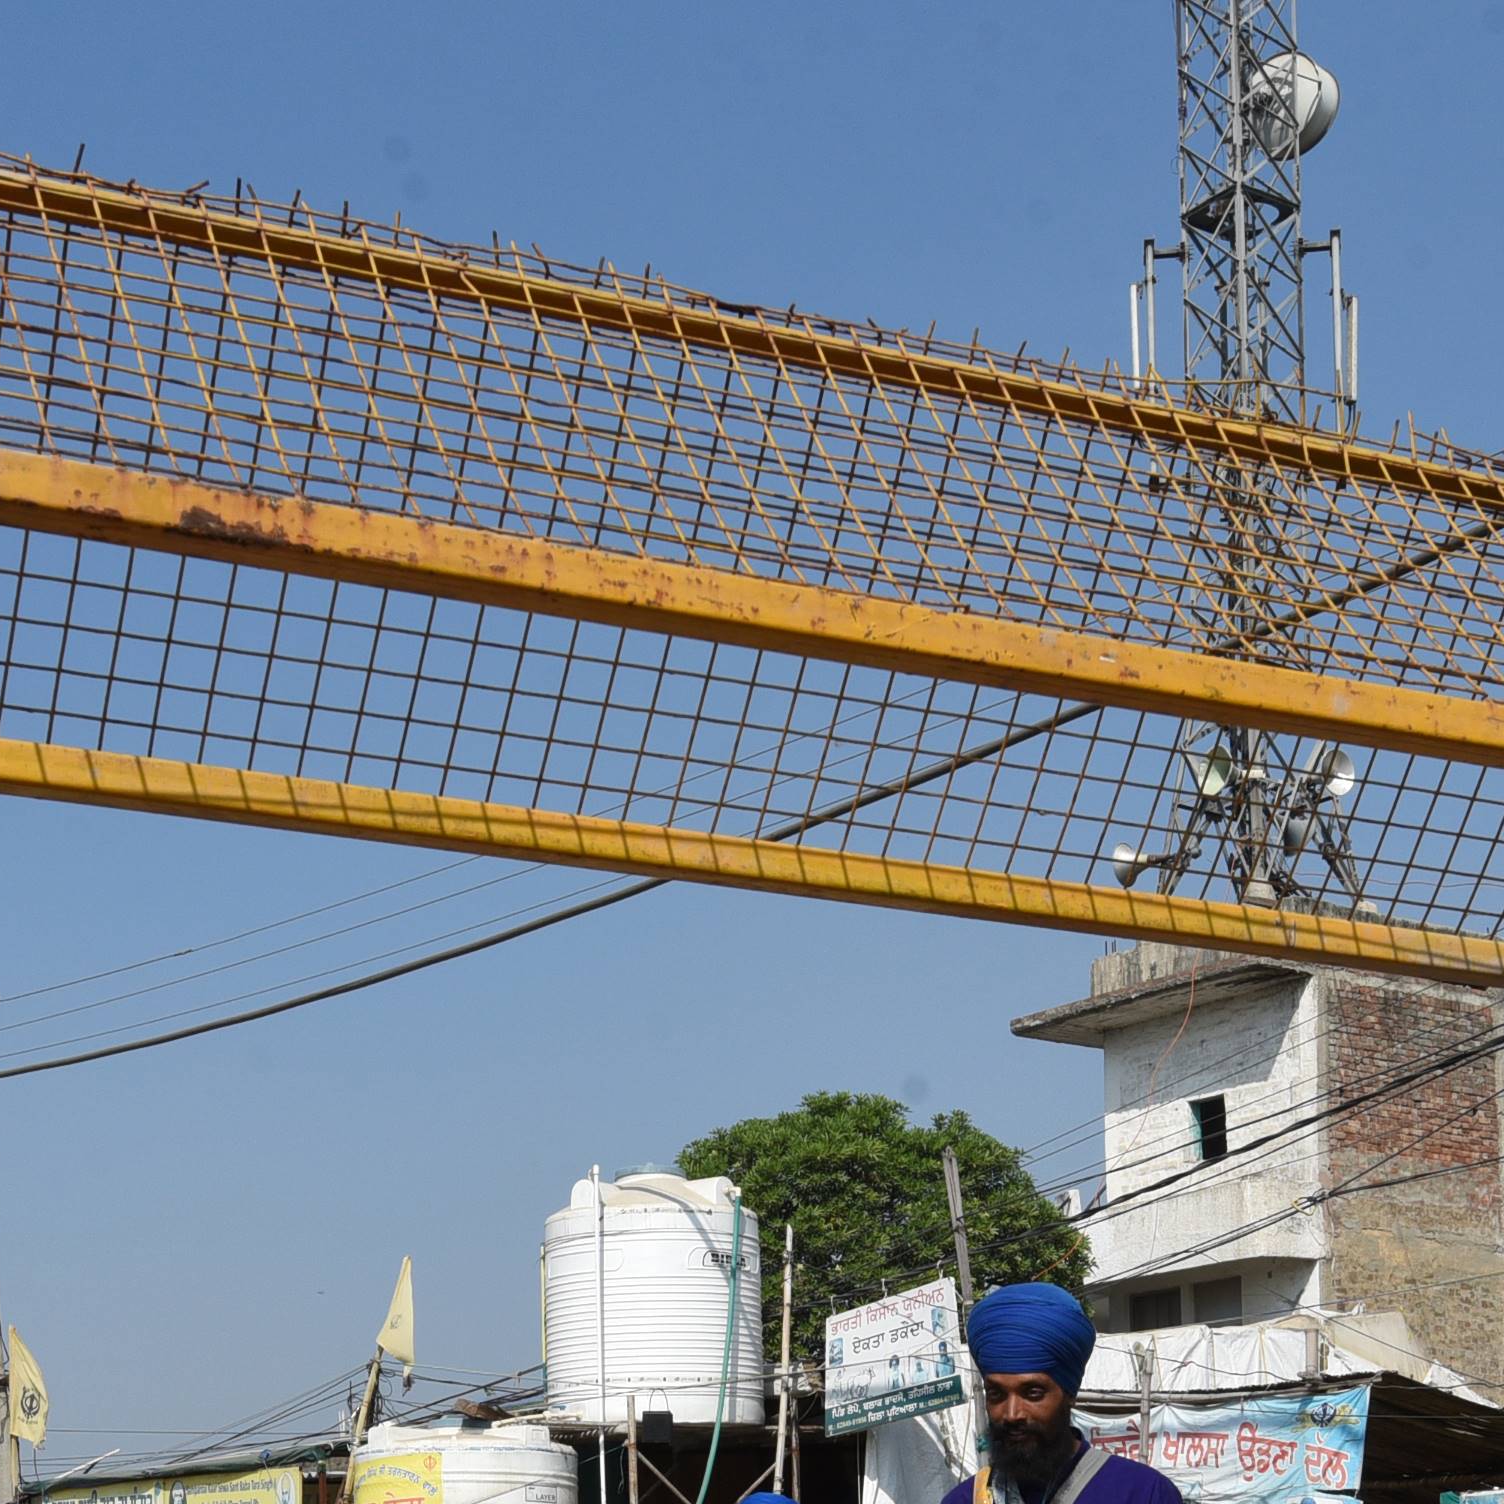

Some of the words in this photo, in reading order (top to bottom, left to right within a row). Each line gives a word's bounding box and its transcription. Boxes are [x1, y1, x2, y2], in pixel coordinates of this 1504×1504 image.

[830, 1310, 862, 1335] ਭਾਰਤੀ
[866, 1301, 897, 1325] ਕਿਸਾਨ
[902, 1287, 944, 1317] ਯੂਨੀਅਨ
[852, 1332, 884, 1354] ਏਕਤਾ
[908, 1385, 935, 1399] ਤਹਿਸੀਲ
[1163, 1430, 1229, 1468] ਖਾਲਸਾ
[1304, 1431, 1349, 1489] ਦੱਲ
[535, 1493, 556, 1501] LAYER
